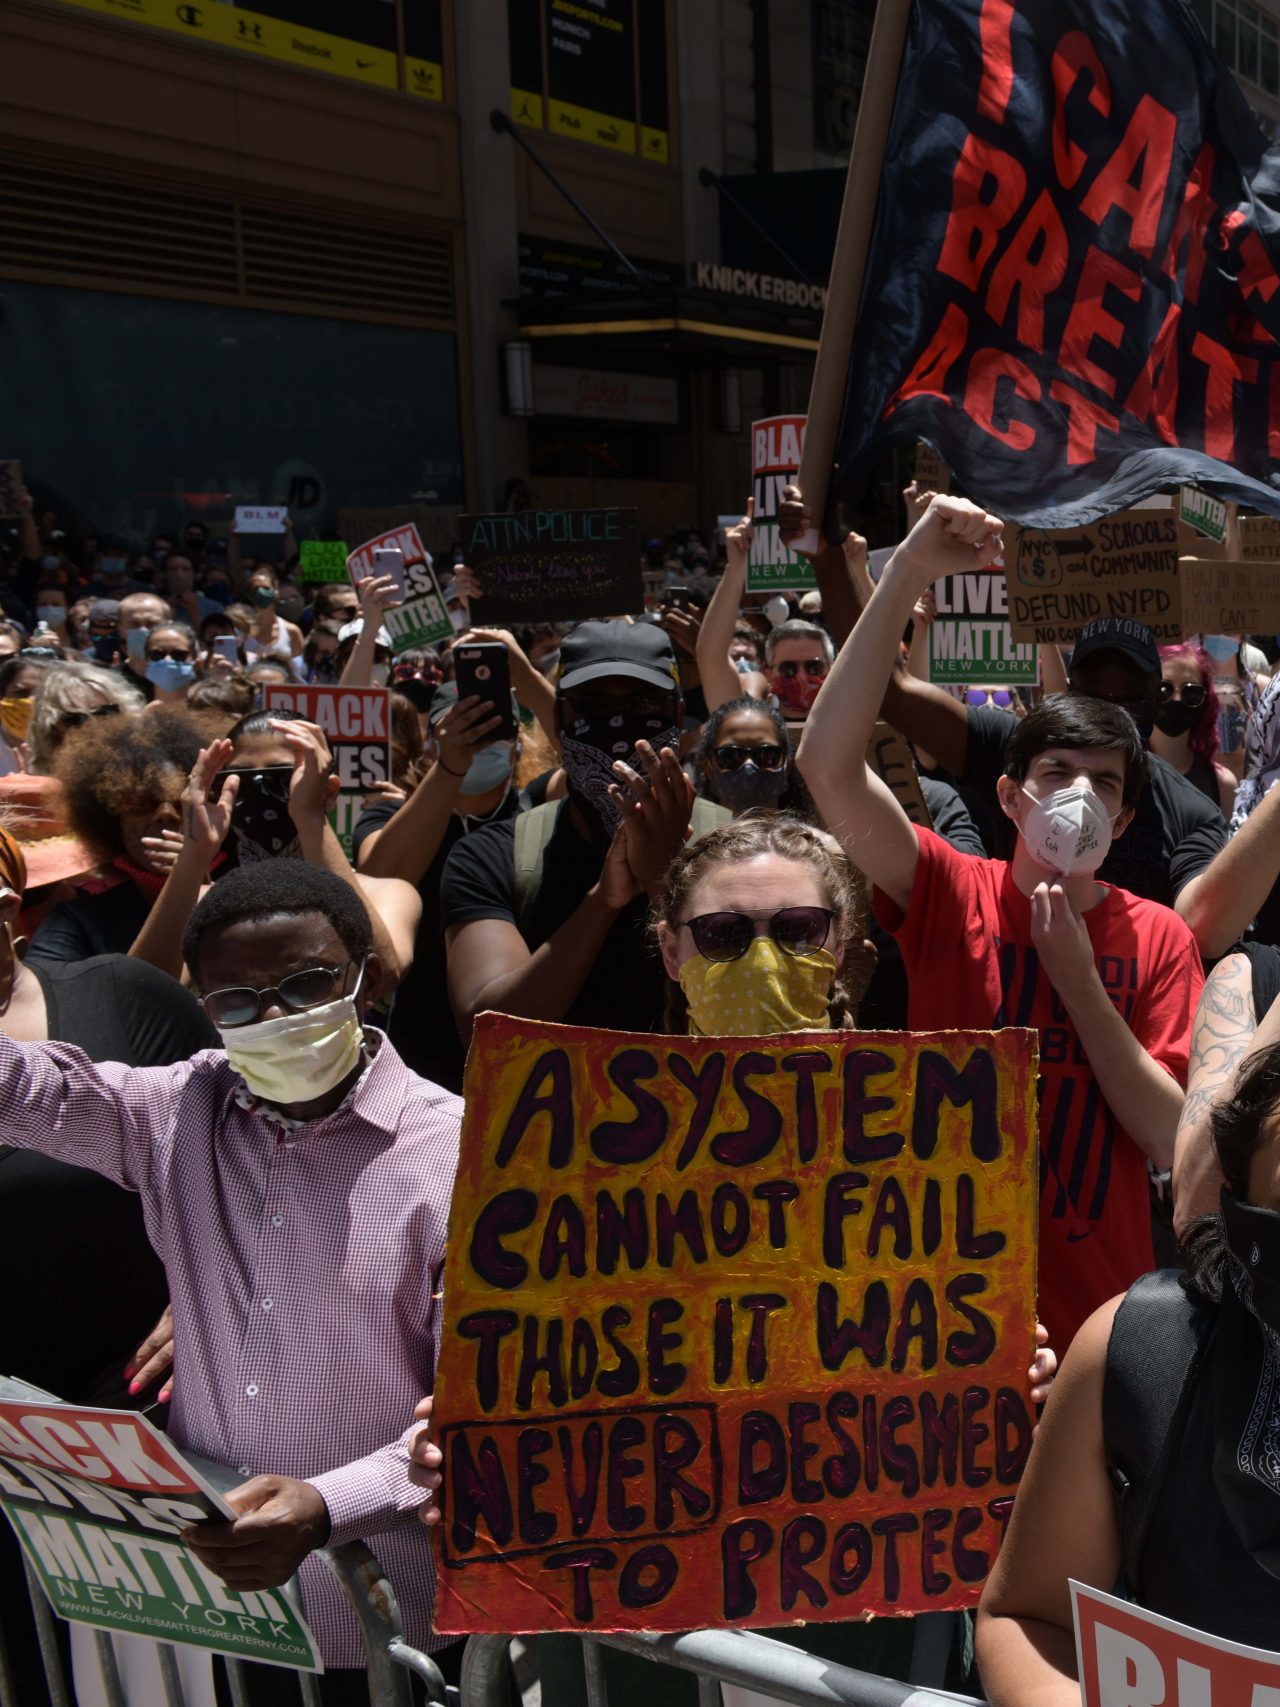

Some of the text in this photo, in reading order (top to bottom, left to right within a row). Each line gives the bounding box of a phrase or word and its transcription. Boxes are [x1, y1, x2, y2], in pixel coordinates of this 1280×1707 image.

[754, 423, 807, 469] BLA
[243, 510, 279, 519] BLM
[1183, 486, 1226, 528] MATTER
[535, 511, 624, 545] POLICE
[1097, 517, 1177, 551] SCHOOLS
[1021, 538, 1053, 558] NYC
[1067, 549, 1179, 578] and COMMUNITY
[751, 566, 787, 577] NEW
[934, 574, 1009, 614] LIVE
[1013, 588, 1170, 623] DEFUND NYPD
[1035, 626, 1056, 644] NO
[1082, 617, 1150, 645] NEW YORK
[935, 661, 1031, 671] NEW YORK
[333, 745, 385, 790] ES
[494, 1048, 1003, 1172] A SYSTEM
[468, 1171, 1007, 1290] CANNOT FAIL
[456, 1272, 1000, 1413] THOSE IT WAS
[450, 1385, 1032, 1553] NEVER DESIGNED
[543, 1495, 1019, 1623] TO PROTECT
[55, 1578, 294, 1640] NEW YORK
